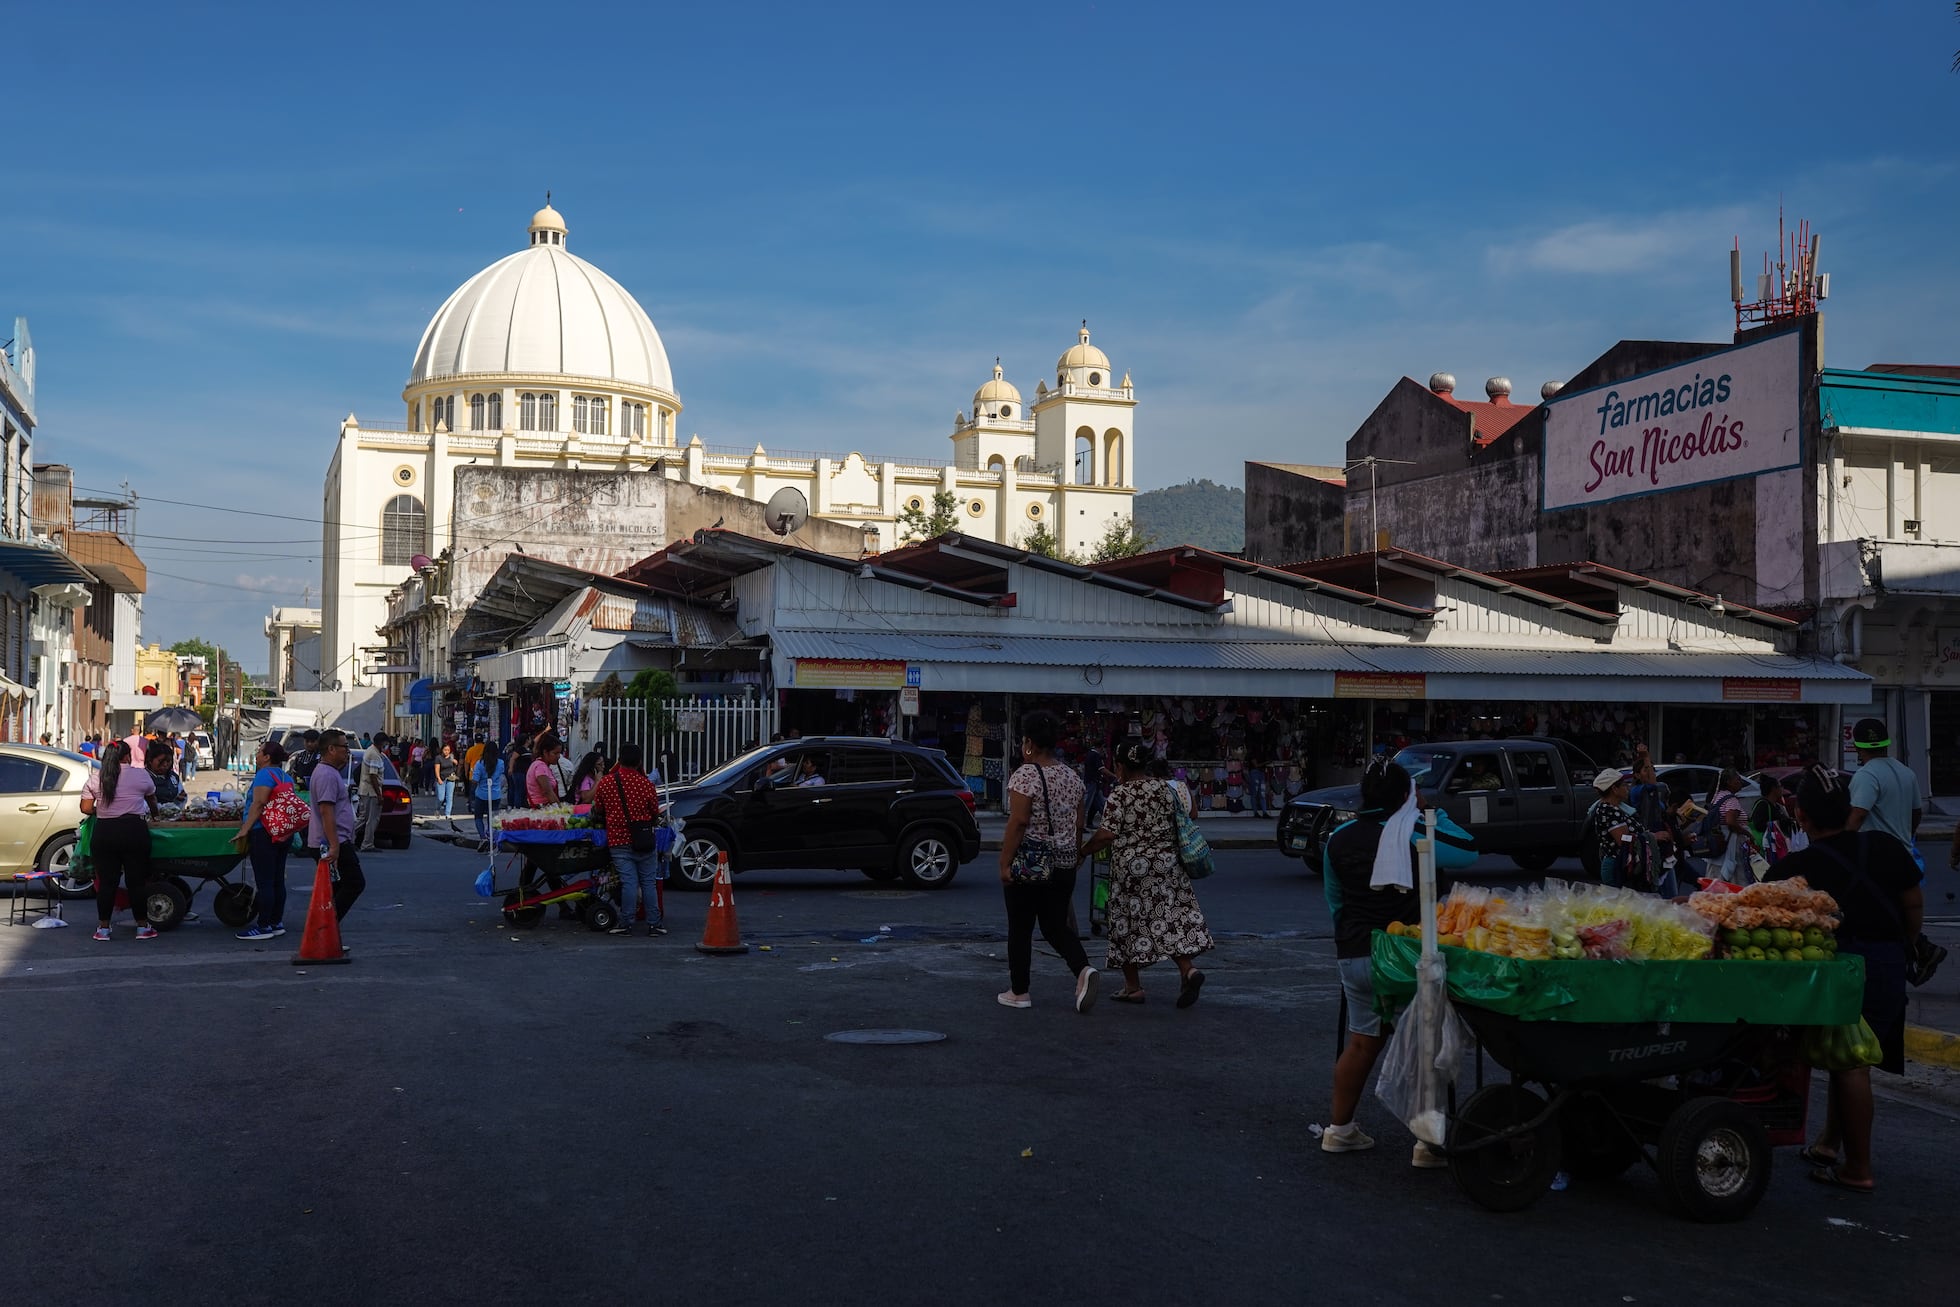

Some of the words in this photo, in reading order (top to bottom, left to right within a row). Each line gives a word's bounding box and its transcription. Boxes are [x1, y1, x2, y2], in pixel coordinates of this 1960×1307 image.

[1597, 373, 1732, 435] farmacias
[1585, 440, 1635, 493] San
[1640, 411, 1744, 485] Nicolás
[598, 524, 616, 533] SAN
[619, 525, 657, 534] NICOLAS
[558, 847, 589, 860] ACE
[1608, 1041, 1687, 1062] TRUPER
